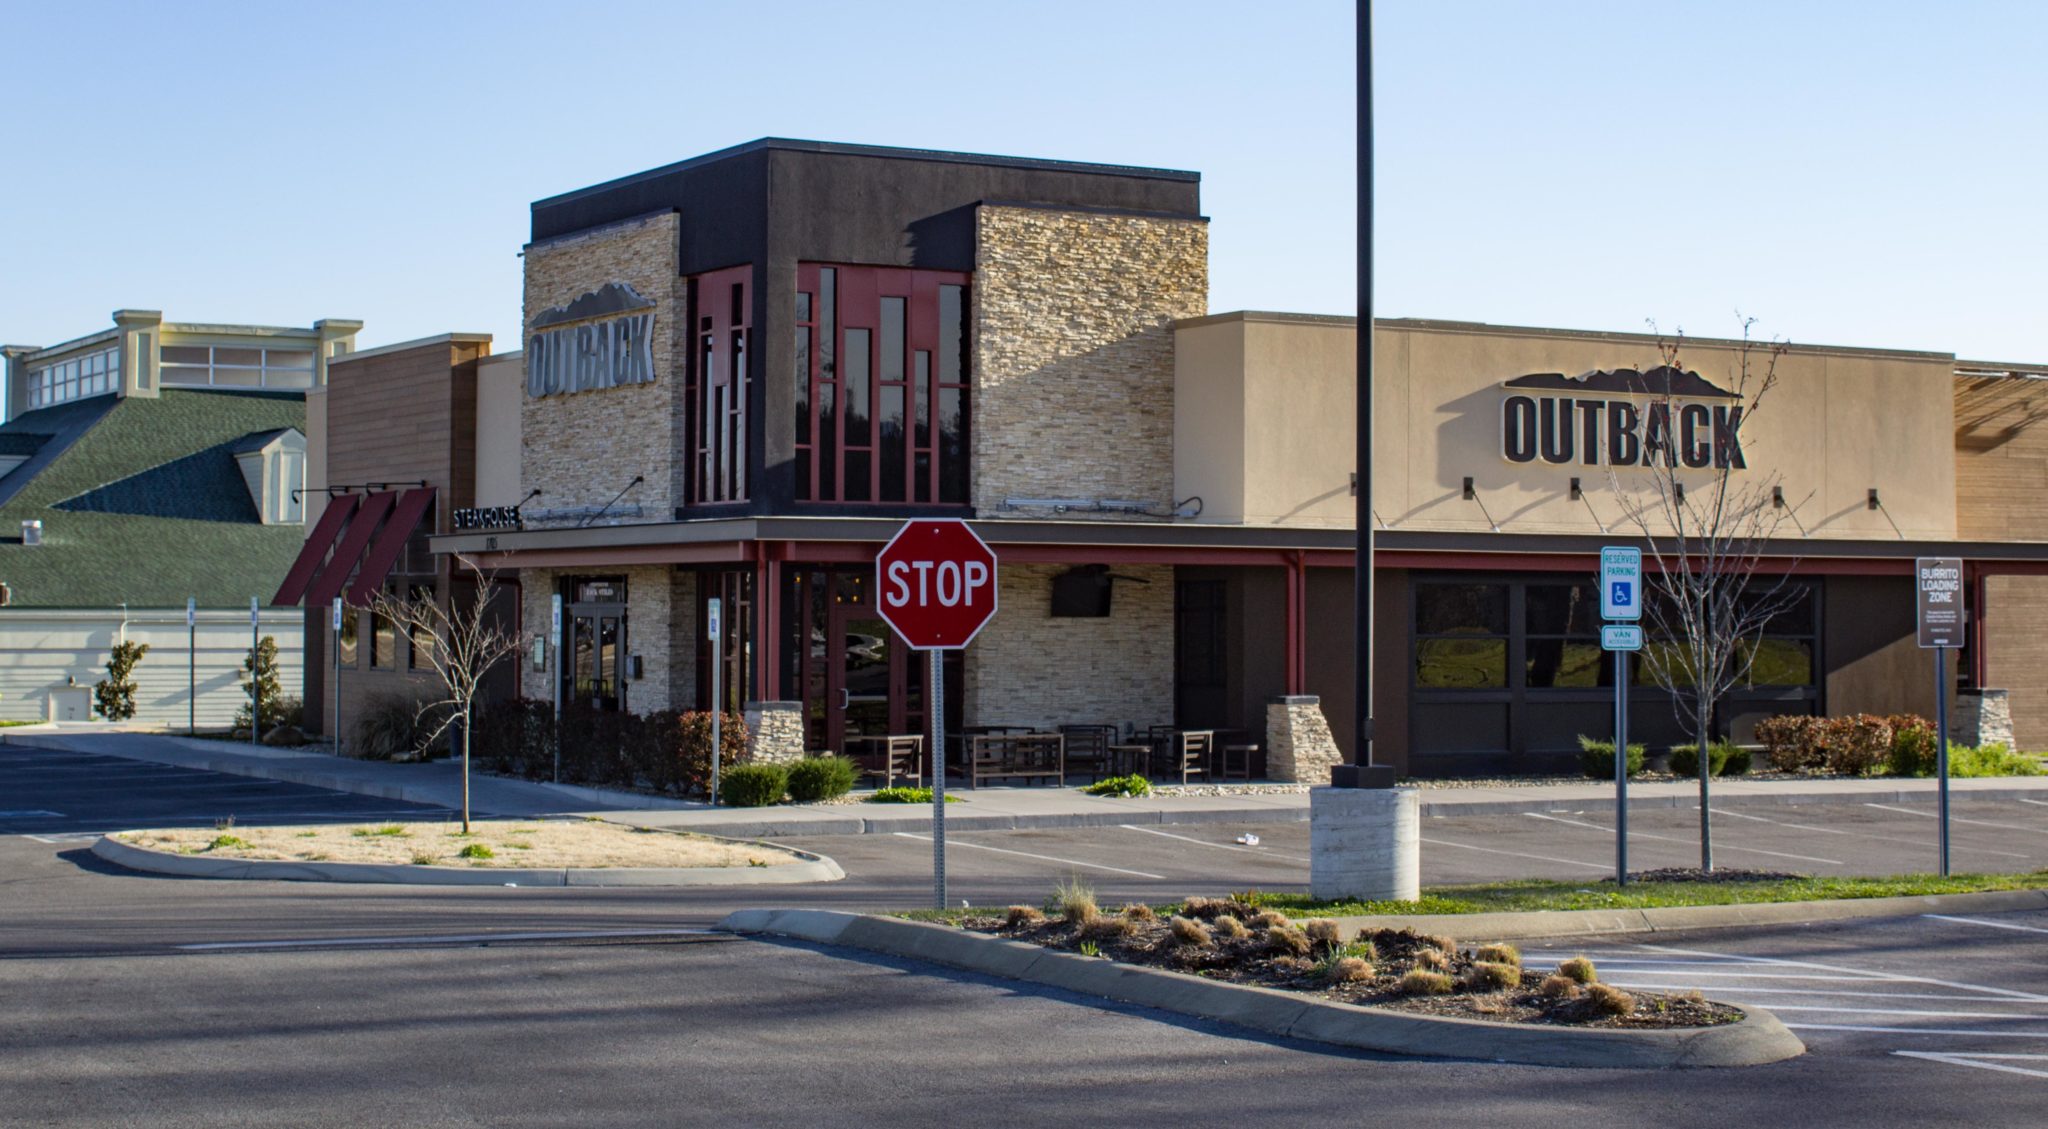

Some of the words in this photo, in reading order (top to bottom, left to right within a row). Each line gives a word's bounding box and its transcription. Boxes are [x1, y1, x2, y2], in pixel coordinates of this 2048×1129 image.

[528, 313, 656, 398] OUTBACK
[1503, 395, 1747, 470] OUTBACK
[453, 505, 516, 529] STEAKHOUSE
[1604, 554, 1638, 565] RESERVED
[1607, 566, 1636, 577] PARKING
[1921, 568, 1959, 579] BURRITO
[886, 560, 988, 607] STOP
[1921, 580, 1959, 591] LOADING
[1928, 592, 1953, 602] ZONE
